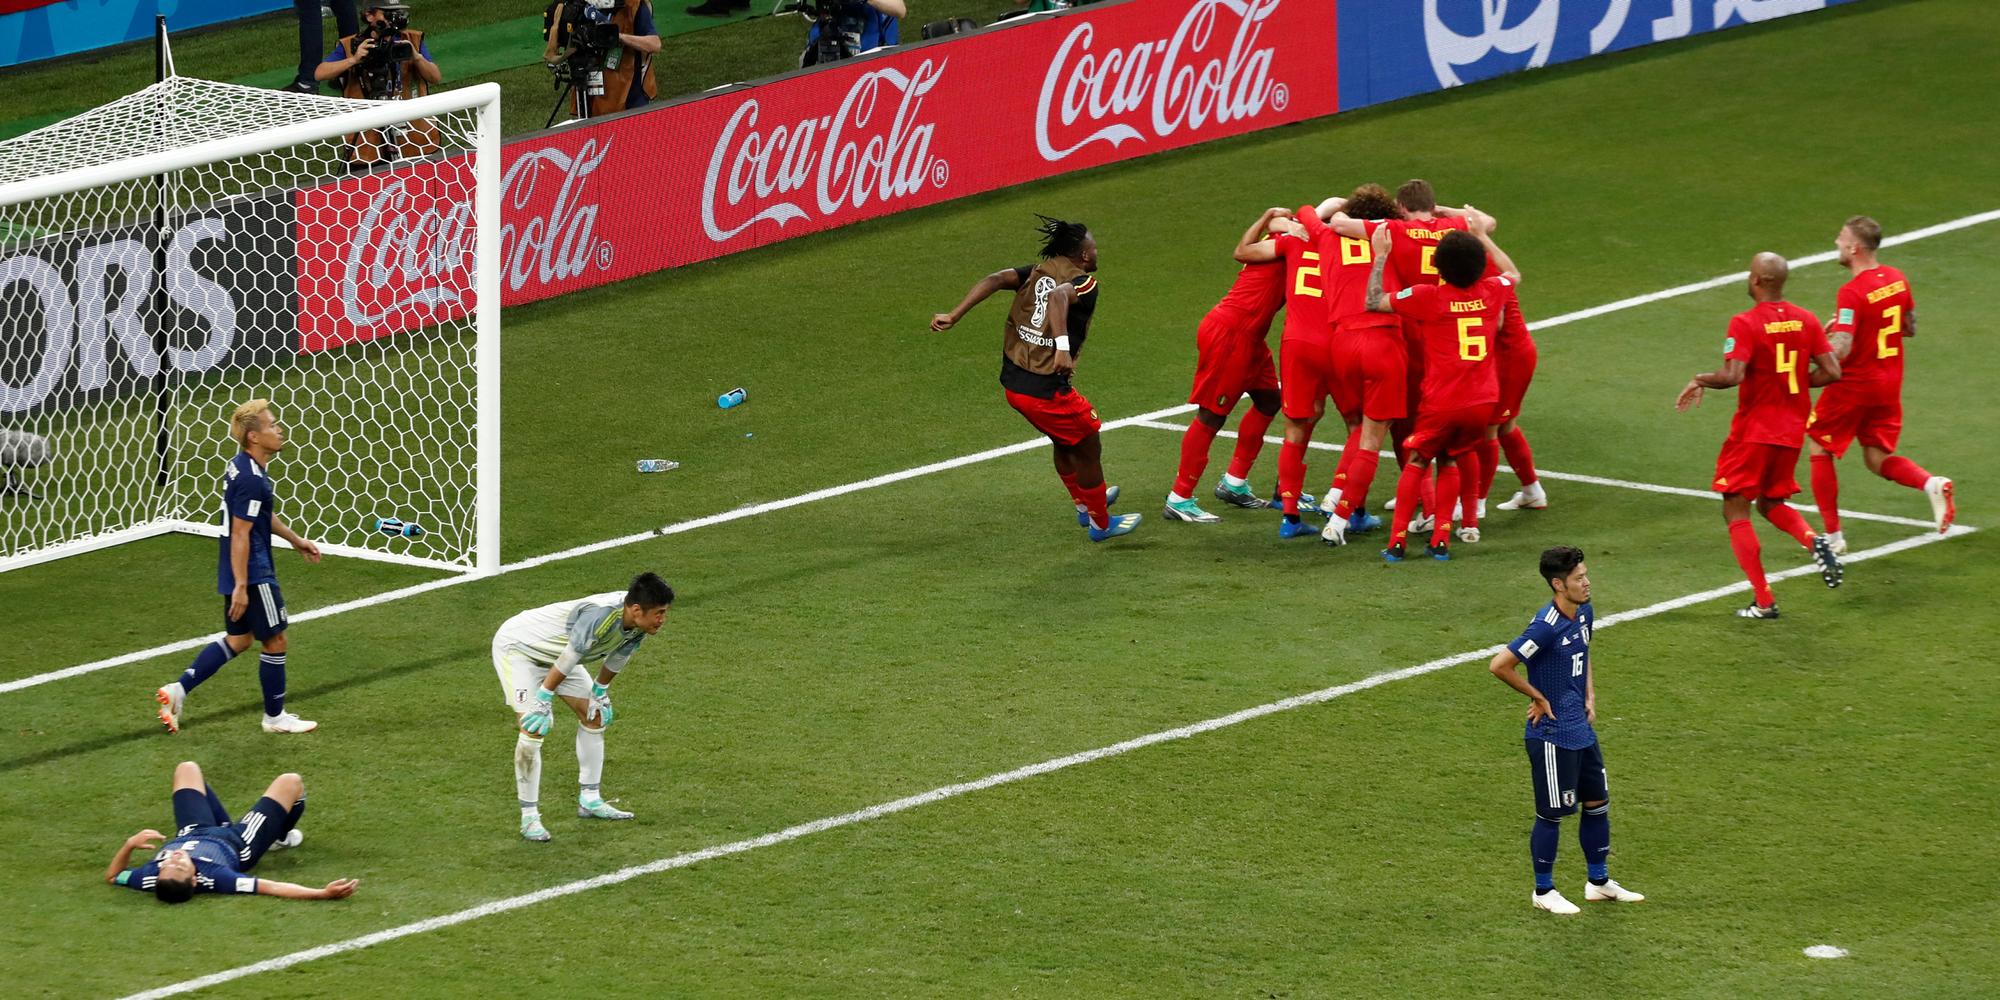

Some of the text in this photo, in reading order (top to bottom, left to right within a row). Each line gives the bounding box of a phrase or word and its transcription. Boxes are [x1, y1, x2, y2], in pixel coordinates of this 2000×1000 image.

[1035, 0, 1281, 162] Coca-Cola
[701, 56, 947, 242] Coca-Cola
[0, 217, 237, 412] ORS
[1457, 317, 1488, 361] 6
[1877, 304, 1902, 360] 2
[1776, 342, 1799, 394] 4
[1571, 651, 1584, 678] 16
